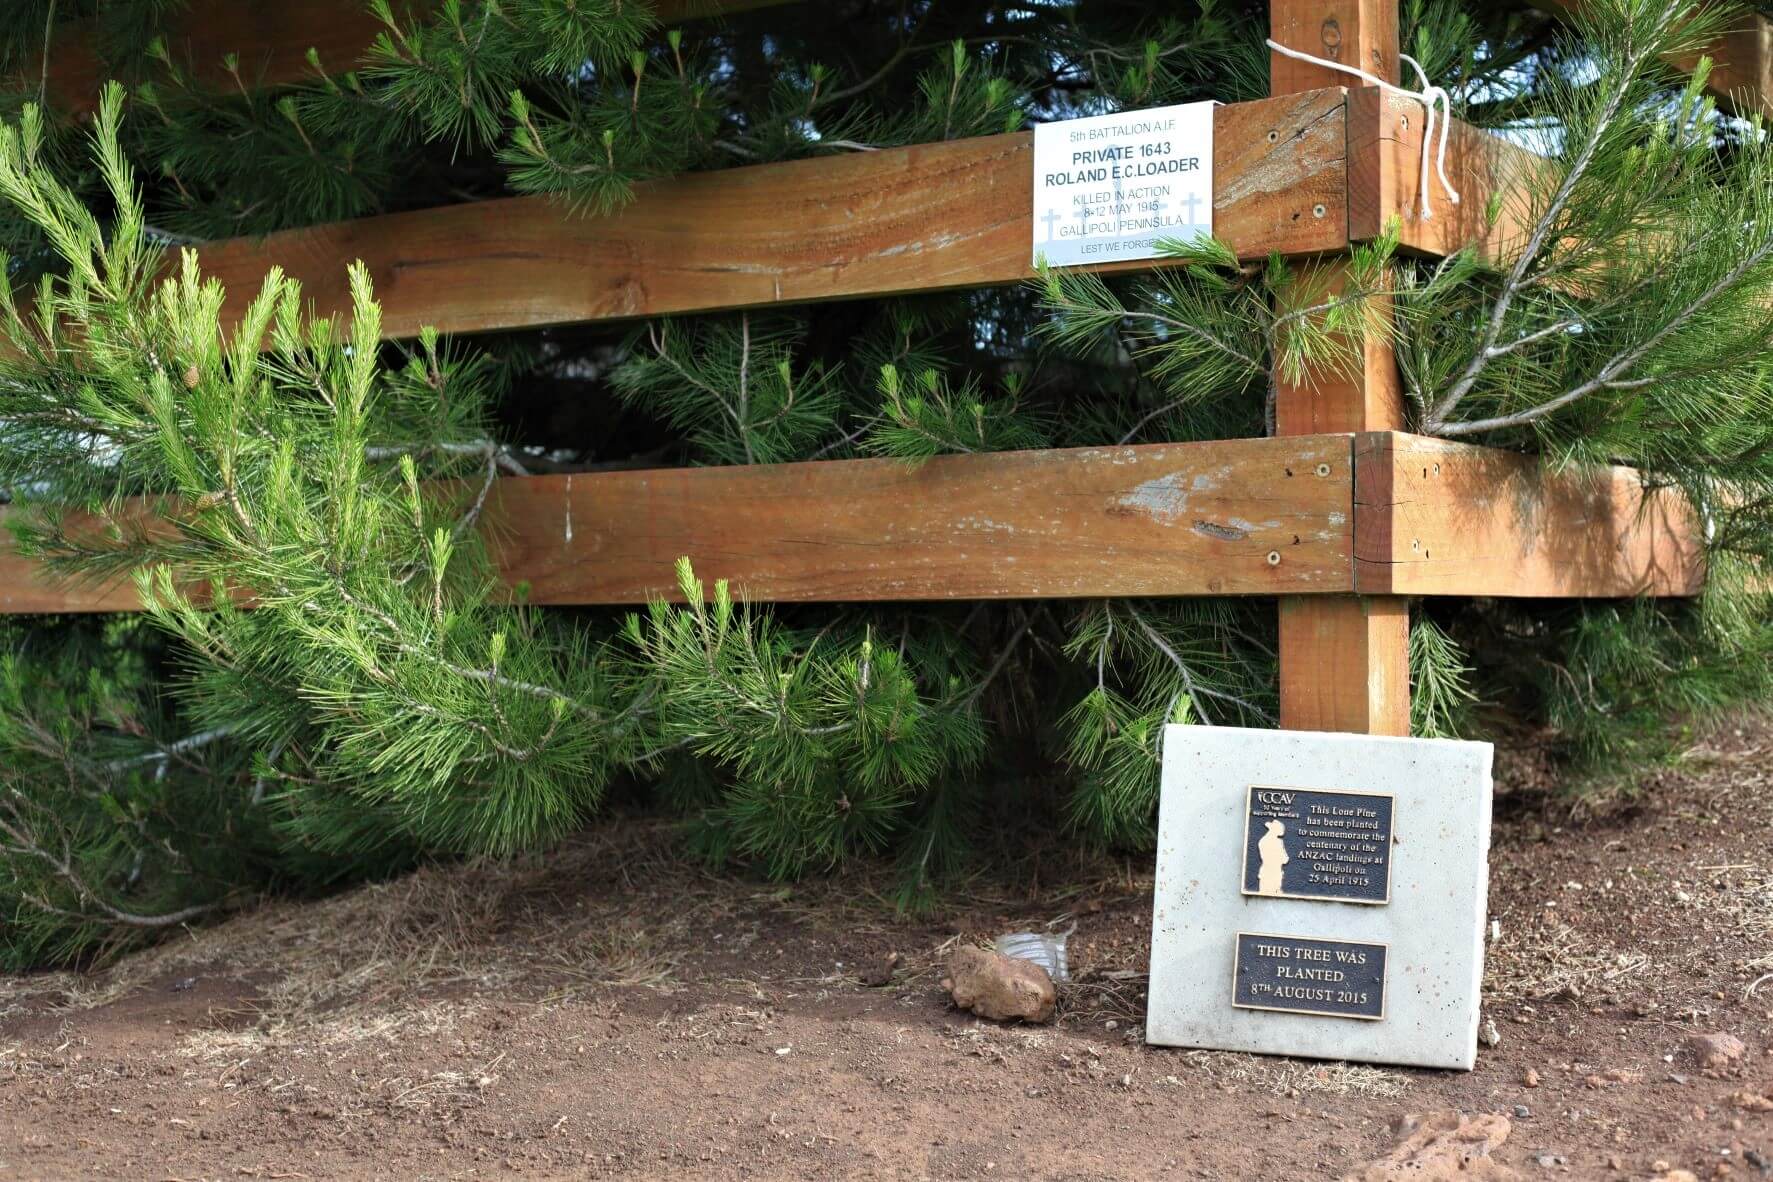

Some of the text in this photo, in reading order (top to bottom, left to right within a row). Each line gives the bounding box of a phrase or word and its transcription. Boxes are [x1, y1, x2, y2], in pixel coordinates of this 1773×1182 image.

[1070, 131, 1086, 142] 5th
[1089, 123, 1151, 140] BATTALION
[1073, 142, 1171, 165] PRIVATE 1643
[1046, 168, 1107, 186] ROLAND
[1073, 186, 1170, 205] KILLED IN ACTION
[1084, 200, 1159, 218] 8-12 MAY 1915
[1060, 215, 1184, 237] GALLIPOLI PENINSULA
[1081, 239, 1157, 253] LEST WE FORGE
[1310, 806, 1376, 817] This Lone Pine
[1306, 816, 1378, 829] has been planted
[1309, 830, 1369, 840] commemorate
[1372, 833, 1385, 841] the
[1306, 841, 1376, 852] centenary of the
[1298, 851, 1383, 864] ANZAC landings at
[1313, 863, 1352, 874] Gallipoli
[1308, 874, 1369, 886] 25 April 1915
[1258, 944, 1366, 964] THIS TREE WAS
[1277, 966, 1344, 982] PLANTED
[1273, 986, 1334, 1001] AUGUST
[1337, 991, 1367, 1004] 2015
